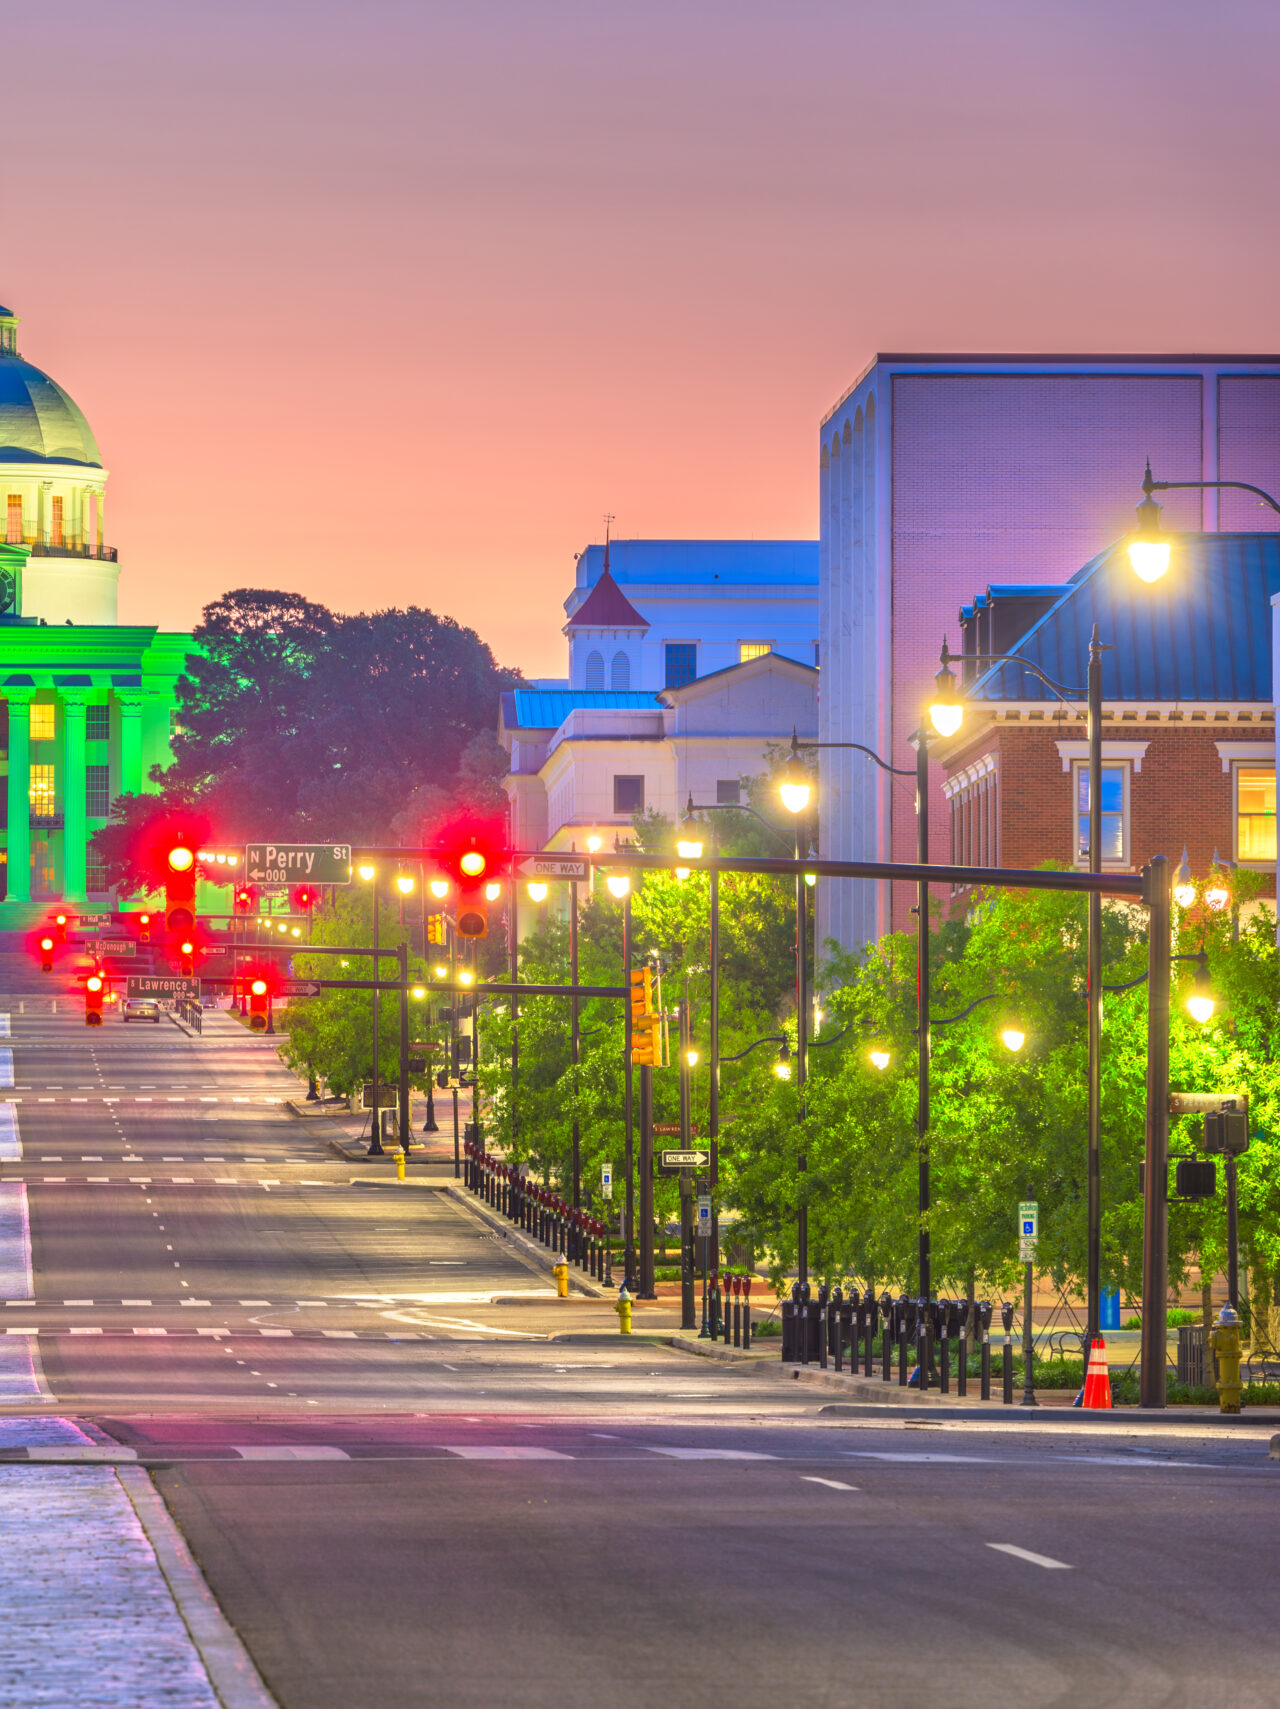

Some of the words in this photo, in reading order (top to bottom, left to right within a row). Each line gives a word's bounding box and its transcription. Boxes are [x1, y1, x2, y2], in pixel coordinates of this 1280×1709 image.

[251, 851, 259, 863] N
[266, 847, 315, 874] Perry
[333, 847, 347, 860] St
[536, 863, 556, 873] ONE
[560, 863, 581, 873] WAY
[265, 869, 287, 882] 000
[139, 978, 188, 991] Lawrence
[1174, 1099, 1180, 1107] S
